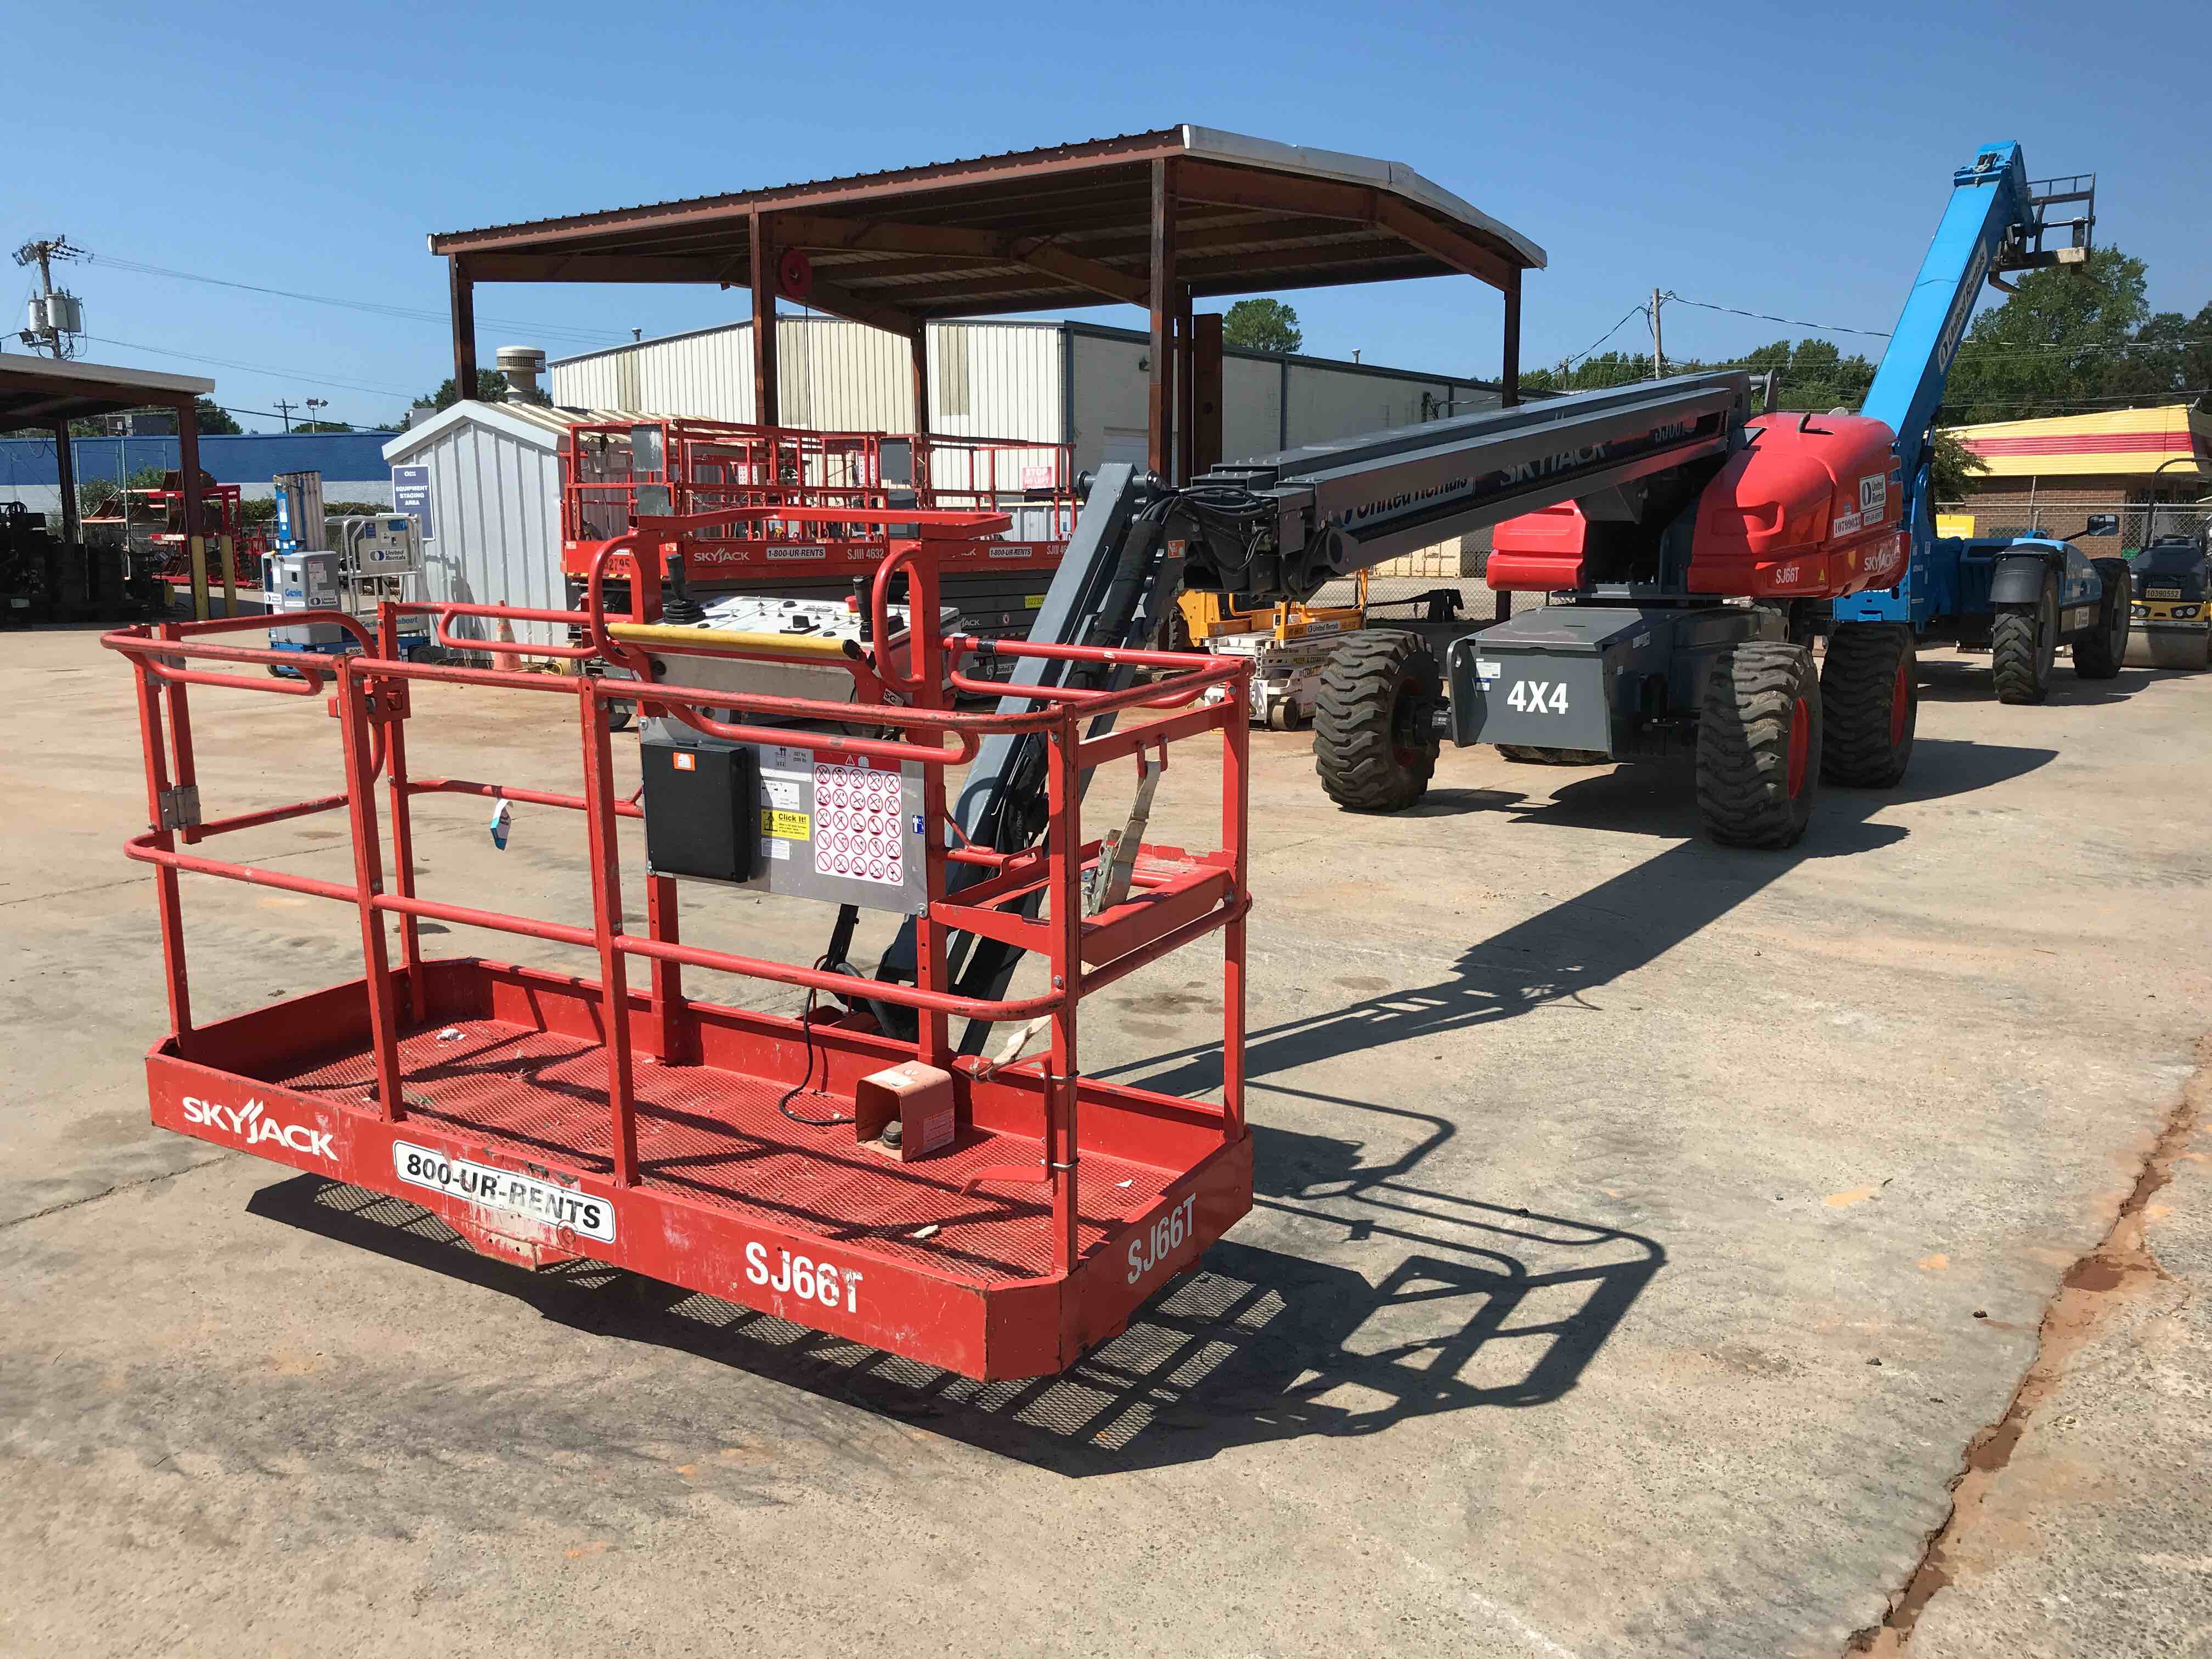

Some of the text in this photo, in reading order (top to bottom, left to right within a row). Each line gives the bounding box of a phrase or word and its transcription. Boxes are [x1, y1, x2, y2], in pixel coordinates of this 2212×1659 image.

[1025, 468, 1047, 477] STOP
[693, 548, 884, 563] SKYJACK 1-800-UR-RENTS SJIII 4632
[1776, 567, 1799, 584] SJ66T
[285, 588, 303, 597] Genie
[960, 617, 980, 628] JACK
[1507, 680, 1568, 714] 4X4
[778, 813, 796, 822] Click
[182, 1097, 339, 1161] SKYJACK
[407, 1153, 601, 1229] 800-UR-RENTS
[1128, 1192, 1196, 1284] SJ66T
[746, 1242, 864, 1313] SJ66T
